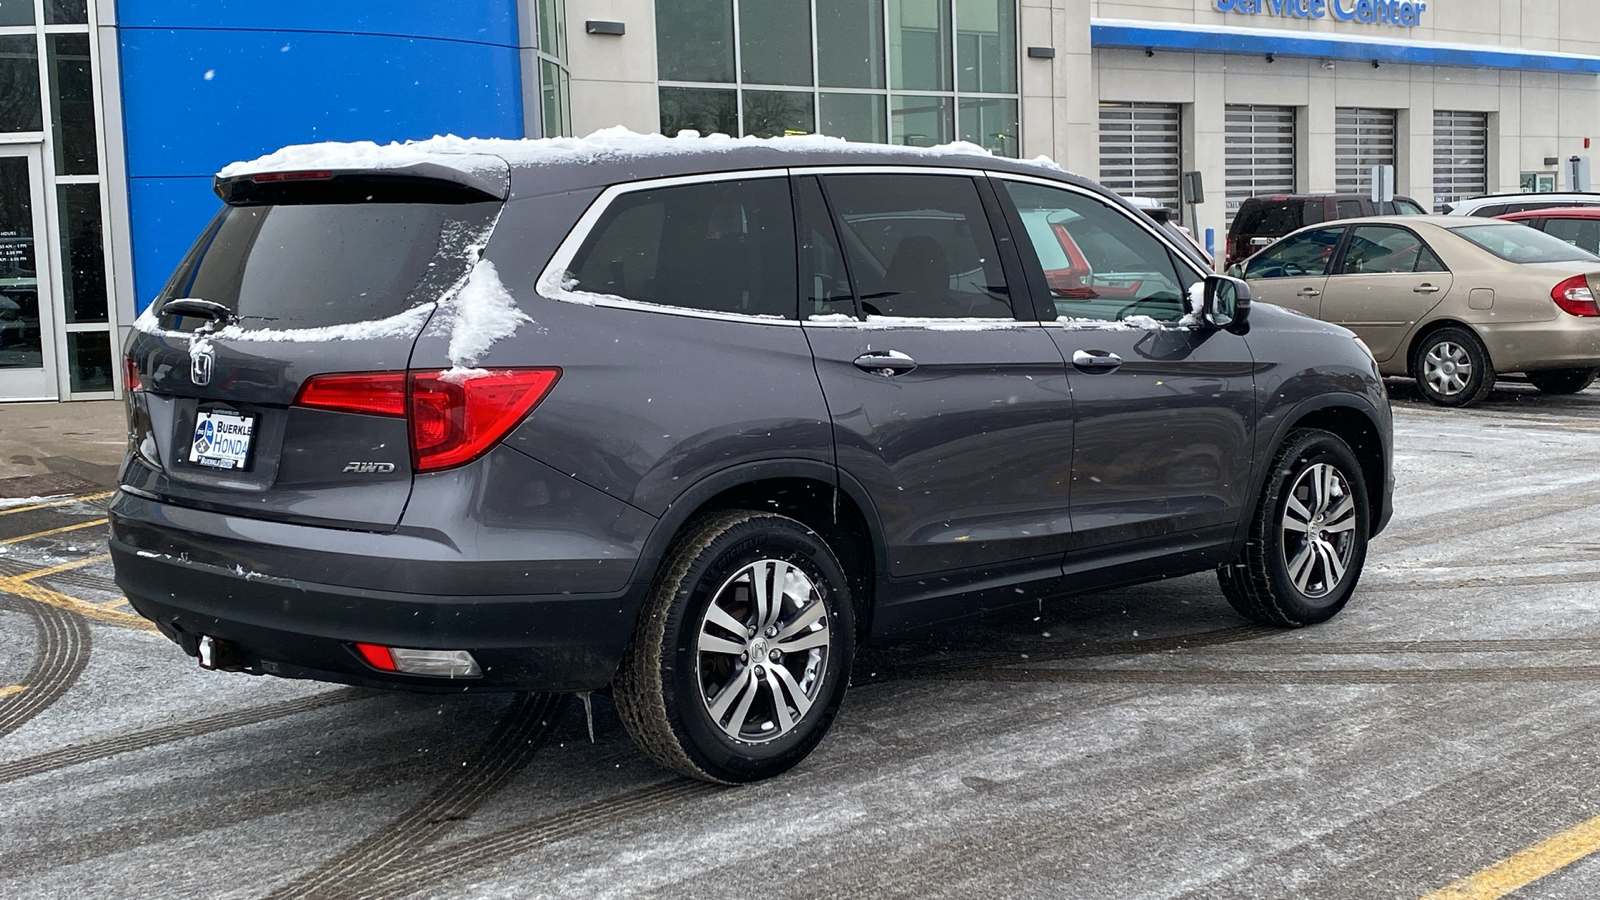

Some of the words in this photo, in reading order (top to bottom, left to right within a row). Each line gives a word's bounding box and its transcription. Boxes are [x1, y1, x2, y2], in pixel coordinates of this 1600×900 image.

[1329, 0, 1426, 26] Center
[216, 421, 252, 436] BUERKLE
[213, 434, 249, 456] HONDA
[342, 461, 395, 473] AWD
